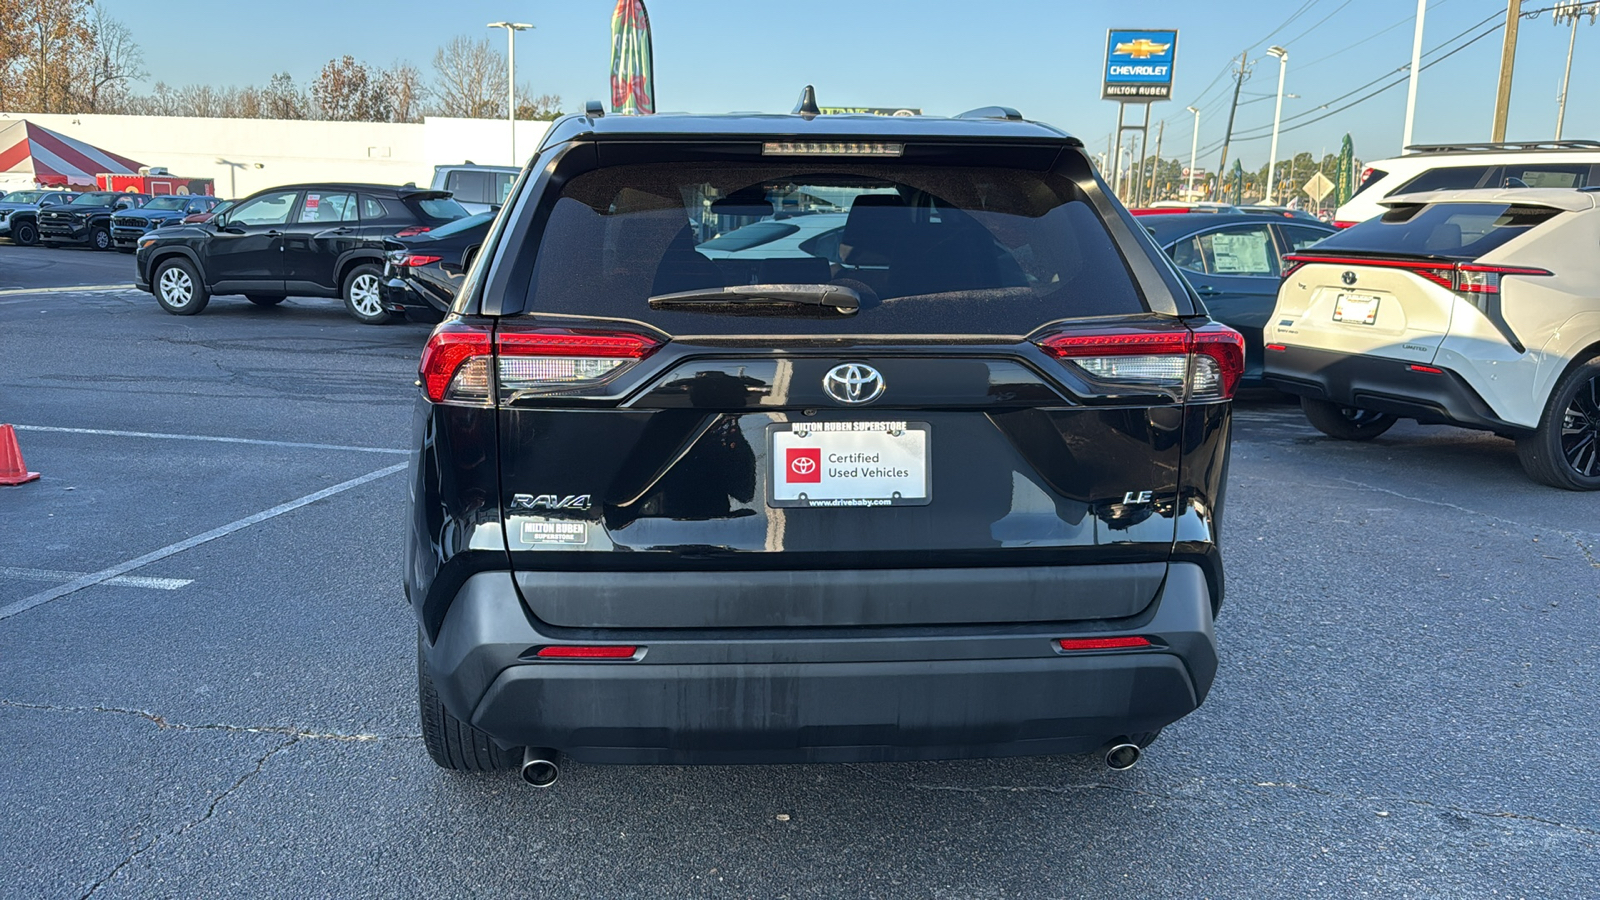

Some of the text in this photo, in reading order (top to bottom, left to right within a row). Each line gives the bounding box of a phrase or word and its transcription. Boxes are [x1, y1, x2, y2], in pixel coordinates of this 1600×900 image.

[1110, 66, 1168, 75] CHEVROLET
[1107, 86, 1168, 95] MILTON RUBEN
[1402, 343, 1428, 352] LIMITED
[792, 421, 907, 432] MILTON RUBEN SUPERSTORE
[828, 453, 880, 464] Certified
[828, 467, 909, 478] Used Vehicles
[511, 493, 591, 510] RAV4
[1123, 490, 1153, 504] LE
[809, 499, 892, 507] www.drivebaby.com
[524, 522, 584, 534] MILTON RUBEN
